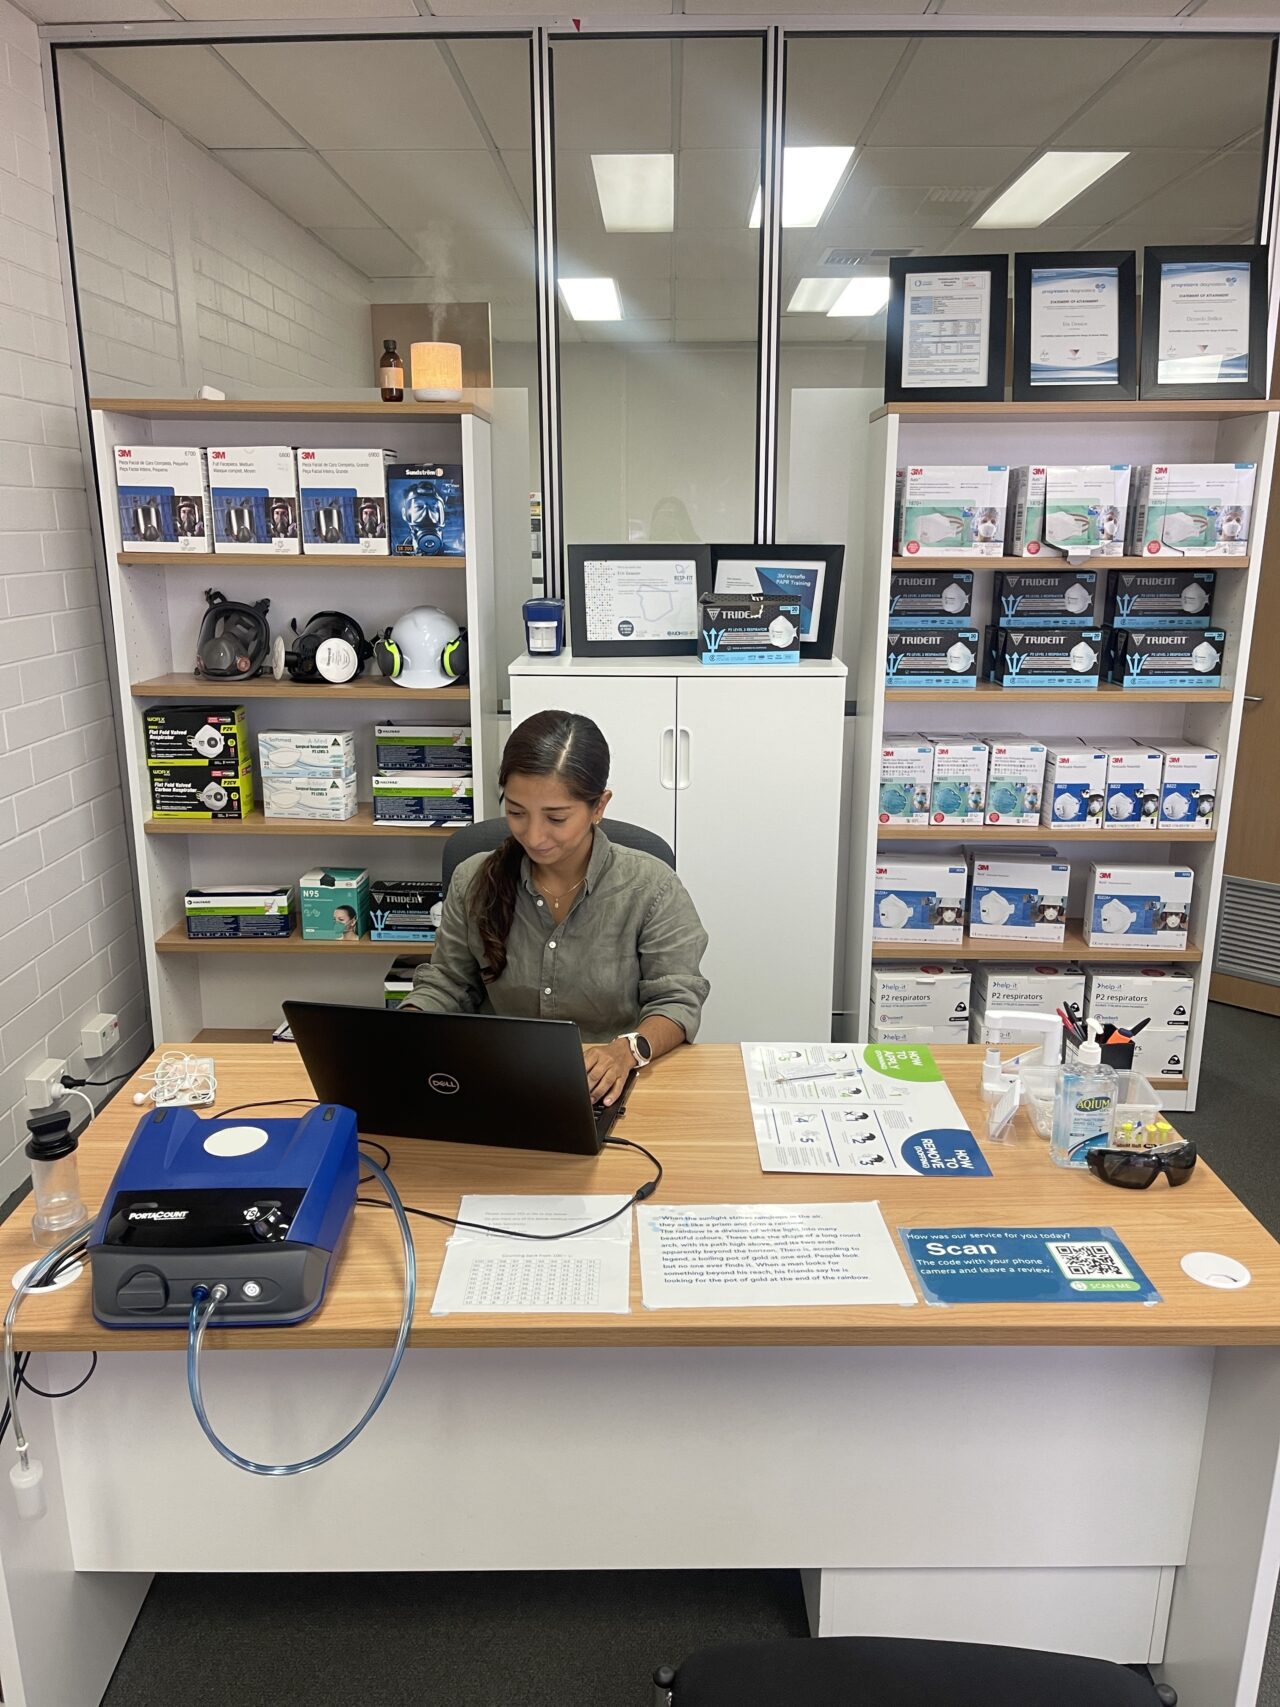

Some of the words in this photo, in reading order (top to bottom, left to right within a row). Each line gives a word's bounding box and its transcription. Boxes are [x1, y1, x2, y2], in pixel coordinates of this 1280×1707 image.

[118, 450, 132, 458] 3M
[302, 452, 315, 460] 3M
[910, 468, 923, 476] 3M
[897, 578, 939, 586] TRIDENT
[1020, 578, 1063, 586] TRIDENT
[1136, 578, 1176, 586] TRIDENT
[900, 636, 944, 644] TRIDENT
[1024, 636, 1068, 644] TRIDENT
[1146, 636, 1188, 644] TRIDENT
[303, 890, 320, 898] N95
[385, 895, 425, 904] TRIDENT
[892, 994, 930, 1002] respirators
[1107, 994, 1148, 1002] respirators
[896, 1051, 908, 1060] TO
[907, 1050, 923, 1066] HOW
[883, 1050, 900, 1070] APPLY
[432, 1080, 456, 1088] DELL
[1077, 1099, 1110, 1110] AQIUM
[920, 1138, 945, 1169] REMOVE
[954, 1149, 975, 1169] HOW
[944, 1158, 959, 1169] TO
[1040, 1232, 1071, 1240] today?
[926, 1242, 997, 1256] Scan
